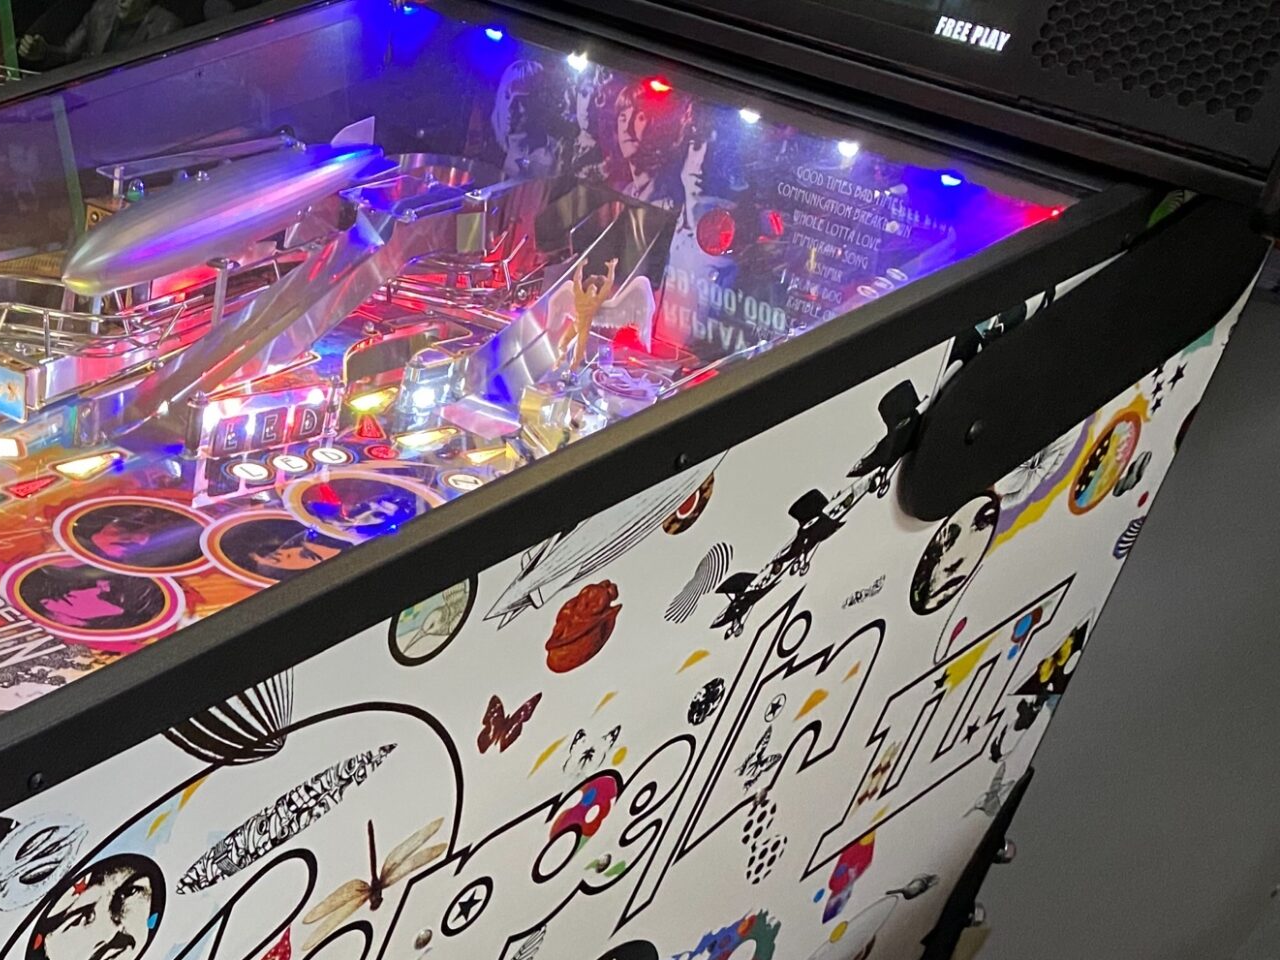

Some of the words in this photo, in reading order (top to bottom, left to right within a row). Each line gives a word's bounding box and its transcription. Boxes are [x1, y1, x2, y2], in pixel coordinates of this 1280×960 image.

[934, 15, 973, 42] FREE
[970, 25, 1011, 52] PLAY
[777, 182, 853, 221] COMMUNICATION
[797, 166, 824, 186] GOOD
[827, 175, 853, 196] TIMES
[854, 185, 874, 203] BAD
[825, 222, 855, 244] LOTTA
[856, 233, 882, 252] LOVE
[842, 250, 869, 270] SONG
